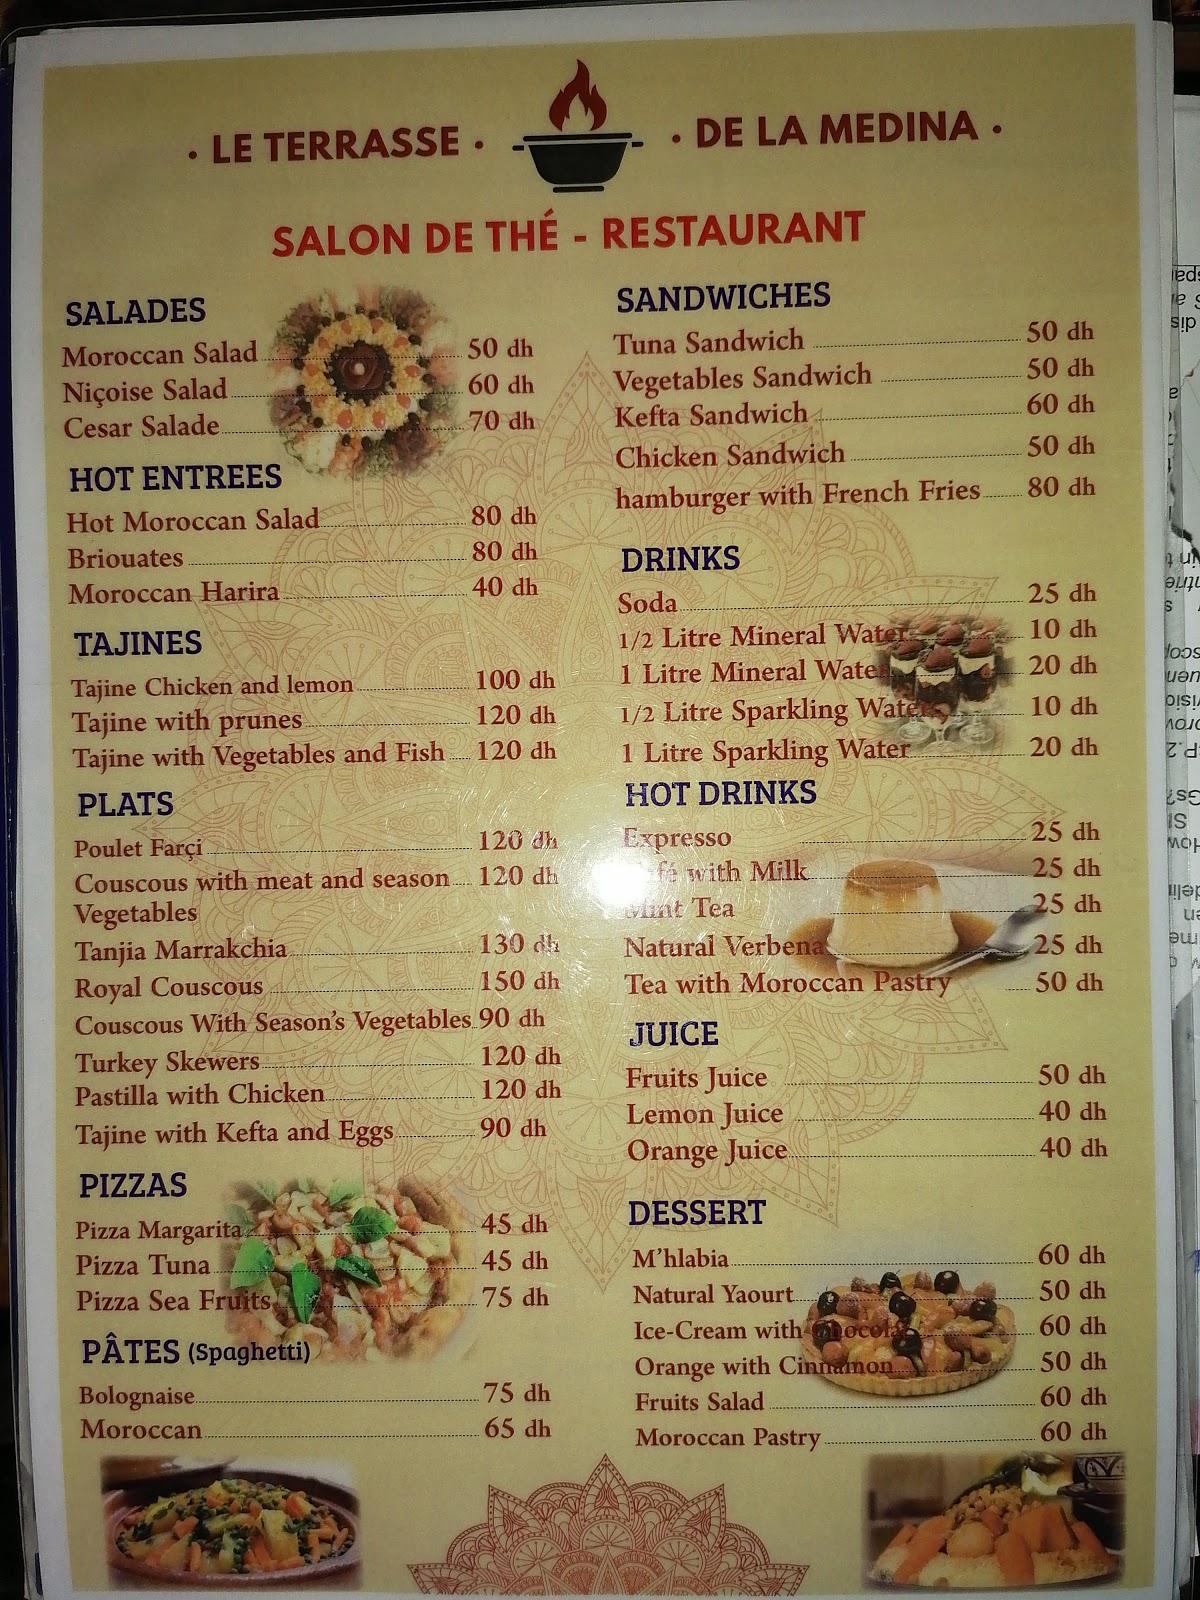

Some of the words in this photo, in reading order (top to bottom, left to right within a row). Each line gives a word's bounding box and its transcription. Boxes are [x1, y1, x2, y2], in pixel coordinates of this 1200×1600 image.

[214, 134, 251, 164] LE
[264, 126, 459, 161] TERRASSE
[697, 117, 743, 148] DE
[758, 115, 808, 146] LA
[820, 111, 979, 144] MEDINA
[272, 224, 409, 257] SALON
[426, 222, 472, 253] DE
[486, 208, 557, 252] THÉ
[604, 210, 865, 249] RESTAURANT
[67, 297, 206, 326] SALADES
[618, 281, 830, 313] SANDWICHES
[62, 347, 184, 367] Moroccan
[194, 340, 258, 364] Salad
[468, 338, 497, 359] 50
[507, 338, 533, 357] dh
[613, 334, 676, 355] Tuna
[686, 327, 804, 353] Sandwich
[1027, 321, 1057, 343] 50
[1067, 321, 1094, 340] dh
[62, 382, 153, 408] Niçoise
[164, 377, 227, 400] Salad
[469, 373, 498, 395] 60
[508, 375, 534, 394] dh
[613, 368, 743, 397] Vegetables
[753, 362, 872, 388] Sandwich
[1027, 357, 1058, 379] 50
[1068, 357, 1094, 377] dh
[64, 417, 132, 439] Cesar
[142, 413, 219, 437] Salade
[469, 410, 499, 431] 70
[509, 411, 535, 430] dh
[70, 467, 134, 492] HOT
[142, 464, 282, 490] ENTREES
[615, 486, 750, 515] hamburger
[758, 483, 813, 505] with
[823, 480, 909, 504] French
[919, 480, 980, 501] Fries
[1028, 477, 1058, 497] 80
[1068, 477, 1095, 496] dh
[68, 549, 183, 569] Briouates
[472, 541, 502, 561] 80
[512, 542, 538, 560] dh
[622, 545, 740, 572] DRINKS
[68, 584, 192, 604] Moroccan
[201, 581, 280, 601] Harira
[472, 577, 502, 597] 40
[512, 577, 538, 596] dh
[618, 591, 678, 614] Soda
[1028, 583, 1058, 604] 25
[1069, 583, 1096, 602] dh
[74, 630, 202, 656] TAJINES
[621, 631, 653, 650] 1/2
[662, 628, 721, 648] Litre
[730, 623, 825, 646] Mineral
[1032, 619, 1060, 639] 10
[1070, 619, 1097, 638] dh
[71, 680, 136, 703] Tajine
[145, 677, 233, 696] Chicken
[241, 675, 279, 694] and
[287, 675, 353, 693] lemon
[477, 670, 520, 690] 100
[529, 670, 556, 689] dh
[73, 749, 144, 774] Tajine
[152, 745, 205, 766] with
[212, 744, 335, 771] Vegetables
[344, 741, 387, 763] and
[395, 741, 445, 761] Fish
[478, 740, 521, 760] 120
[531, 741, 557, 759] dh
[78, 791, 173, 817] PLATS
[626, 782, 690, 806] HOT
[699, 780, 816, 805] DRINKS
[74, 839, 142, 858] Poulet
[150, 839, 203, 861] Farçi
[480, 830, 522, 850] 120
[532, 831, 557, 849] dh
[623, 827, 731, 853] Expresso
[1032, 821, 1062, 842] 25
[1073, 822, 1100, 840] dh
[75, 942, 146, 967] Tanjia
[155, 937, 287, 959] Marrakchia
[481, 933, 524, 954] 130
[534, 934, 559, 952] dh
[624, 935, 715, 957] Natural
[723, 934, 825, 957] Verbena
[1035, 934, 1064, 955] 25
[1075, 935, 1103, 954] dh
[624, 974, 667, 994] Tea
[676, 971, 730, 993] with
[740, 972, 864, 993] Moroccan
[873, 970, 951, 998] Pastry
[1036, 972, 1066, 992] 50
[1076, 973, 1104, 991] dh
[76, 1016, 183, 1035] Couscous
[190, 1012, 247, 1032] With
[352, 1009, 471, 1037] Vegetables
[480, 1008, 509, 1029] 90
[519, 1008, 545, 1027] dh
[630, 1021, 718, 1046] JUICE
[75, 1051, 158, 1079] Turkey
[167, 1050, 259, 1071] Skewers
[483, 1045, 525, 1066] 120
[535, 1046, 561, 1065] dh
[626, 1068, 698, 1088] Fruits
[705, 1067, 767, 1094] Juice
[1039, 1064, 1069, 1085] 50
[1079, 1065, 1106, 1084] dh
[75, 1125, 146, 1151] Tajine
[155, 1122, 207, 1143] with
[216, 1120, 279, 1142] Kefta
[288, 1119, 330, 1141] and
[338, 1120, 393, 1147] Eggs
[481, 1117, 511, 1139] 90
[521, 1119, 547, 1137] dh
[628, 1139, 718, 1168] Orange
[725, 1139, 787, 1166] Juice
[1040, 1137, 1071, 1158] 40
[1081, 1138, 1108, 1157] dh
[80, 1172, 187, 1198] PIZZAS
[629, 1200, 766, 1225] DESSERT
[76, 1222, 130, 1239] Pizza
[138, 1220, 243, 1245] Margarita
[481, 1213, 511, 1234] 45
[522, 1214, 548, 1233] dh
[1039, 1243, 1069, 1265] 60
[1079, 1245, 1106, 1264] dh
[76, 1291, 139, 1311] Pizza
[149, 1290, 190, 1311] Sea
[199, 1289, 271, 1311] Fruits
[483, 1286, 512, 1308] 75
[523, 1287, 549, 1306] dh
[633, 1284, 714, 1304] Natural
[721, 1285, 795, 1303] Yaourt
[1040, 1280, 1069, 1301] 50
[1080, 1281, 1106, 1299] dh
[82, 1332, 180, 1364] PÂTES
[189, 1341, 311, 1365] (Spaghetti)
[635, 1357, 715, 1382] Orange
[722, 1355, 771, 1375] with
[779, 1353, 893, 1375] Cinnamon
[1041, 1351, 1070, 1372] 50
[1081, 1352, 1107, 1370] dh
[79, 1386, 194, 1408] Bolognaise
[484, 1382, 513, 1403] 75
[524, 1383, 551, 1402] dh
